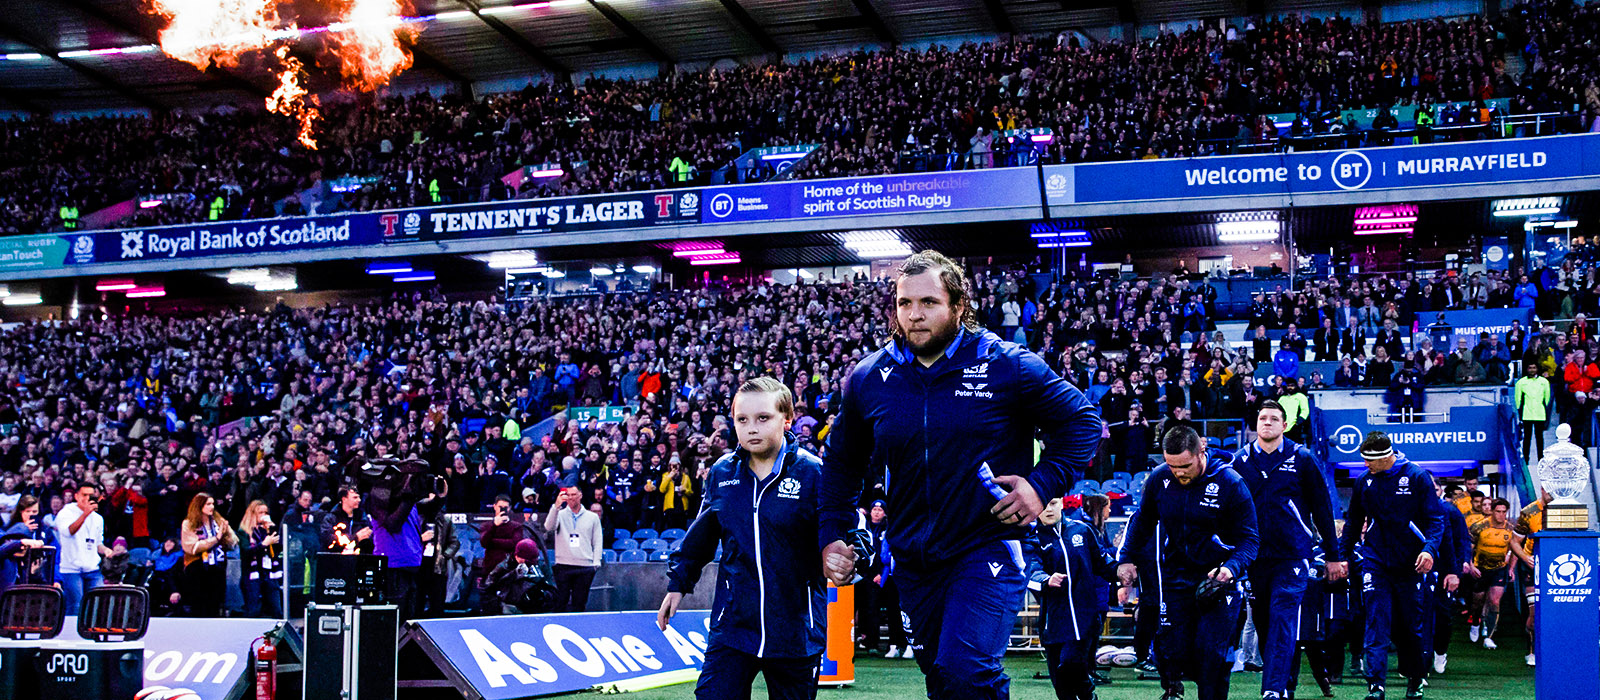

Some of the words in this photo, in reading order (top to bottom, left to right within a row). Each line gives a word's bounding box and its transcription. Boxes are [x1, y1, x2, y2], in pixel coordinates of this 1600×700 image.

[1185, 166, 1288, 186] Welcome
[1297, 163, 1322, 181] to
[1340, 162, 1363, 179] BT
[1397, 152, 1547, 176] MURRAYFIELD
[803, 185, 844, 199] Home
[845, 182, 860, 196] of
[861, 181, 884, 195] the
[886, 176, 970, 193] unbreakable
[715, 200, 729, 211] BT
[737, 203, 769, 212] Business
[803, 199, 835, 215] spirit
[837, 197, 851, 211] of
[853, 195, 906, 210] Scottish
[907, 193, 952, 209] Rugby
[430, 206, 561, 233] TENNENT'S
[565, 200, 645, 225] LAGER
[148, 230, 196, 258] Royal
[199, 226, 244, 251] Bank
[245, 224, 267, 248] of
[269, 219, 350, 246] Scotland
[974, 390, 994, 399] Vardy
[577, 411, 591, 421] 15
[1339, 433, 1357, 445] BT
[1553, 595, 1587, 603] RUGBY
[458, 628, 559, 689] As
[542, 623, 663, 678] One
